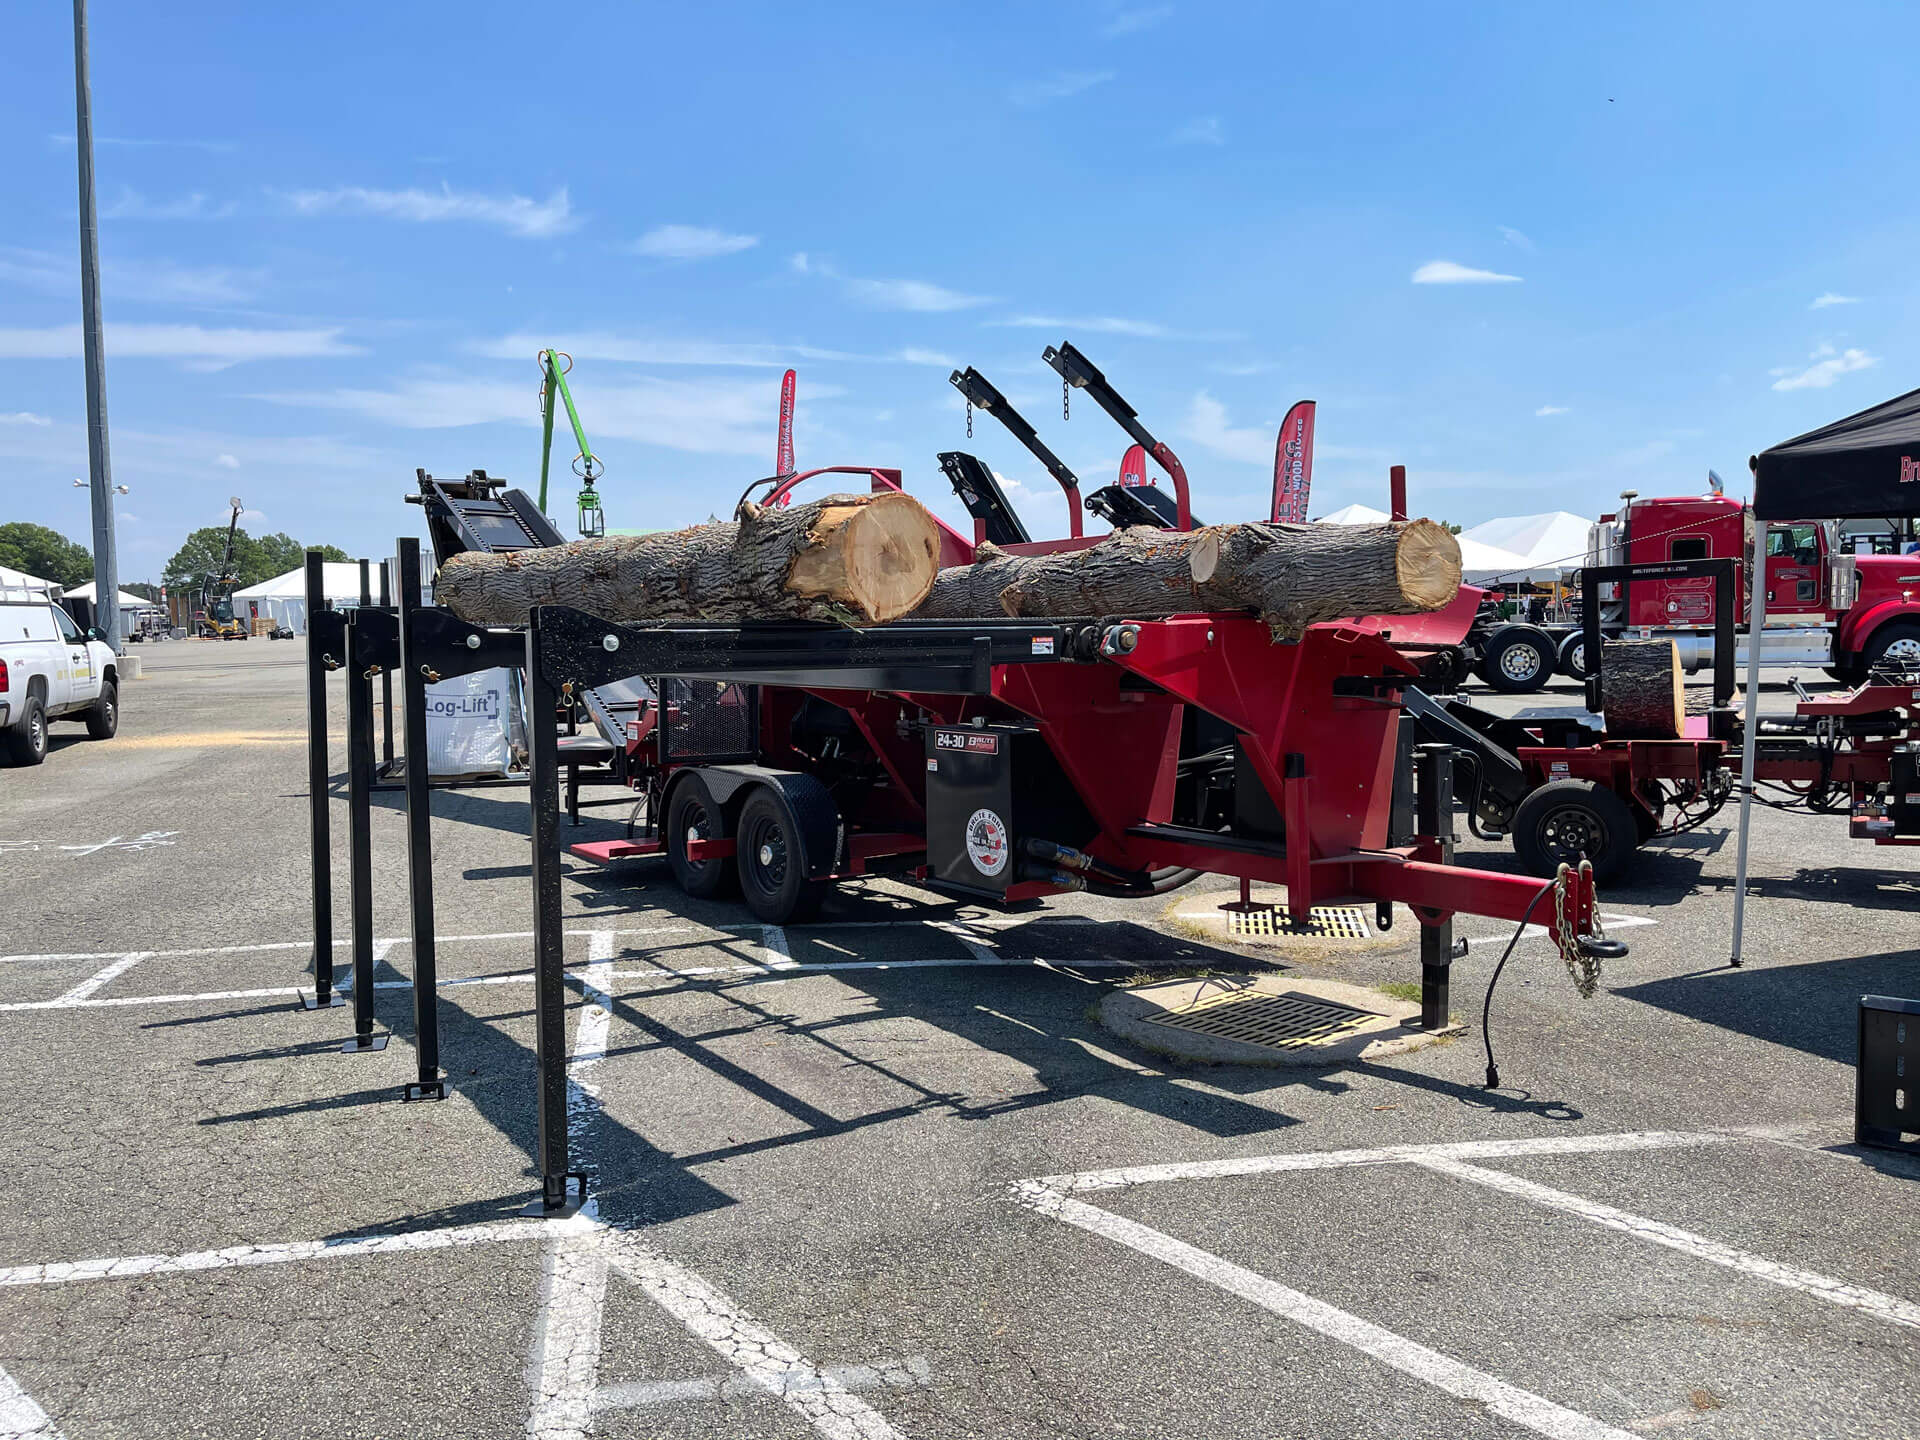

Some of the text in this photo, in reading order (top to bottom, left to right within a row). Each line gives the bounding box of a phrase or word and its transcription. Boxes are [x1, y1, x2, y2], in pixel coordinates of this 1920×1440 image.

[1293, 460, 1303, 490] WOOD
[425, 697, 488, 716] Log-Lift
[937, 734, 964, 748] 24-30
[969, 811, 985, 831] BRUTE
